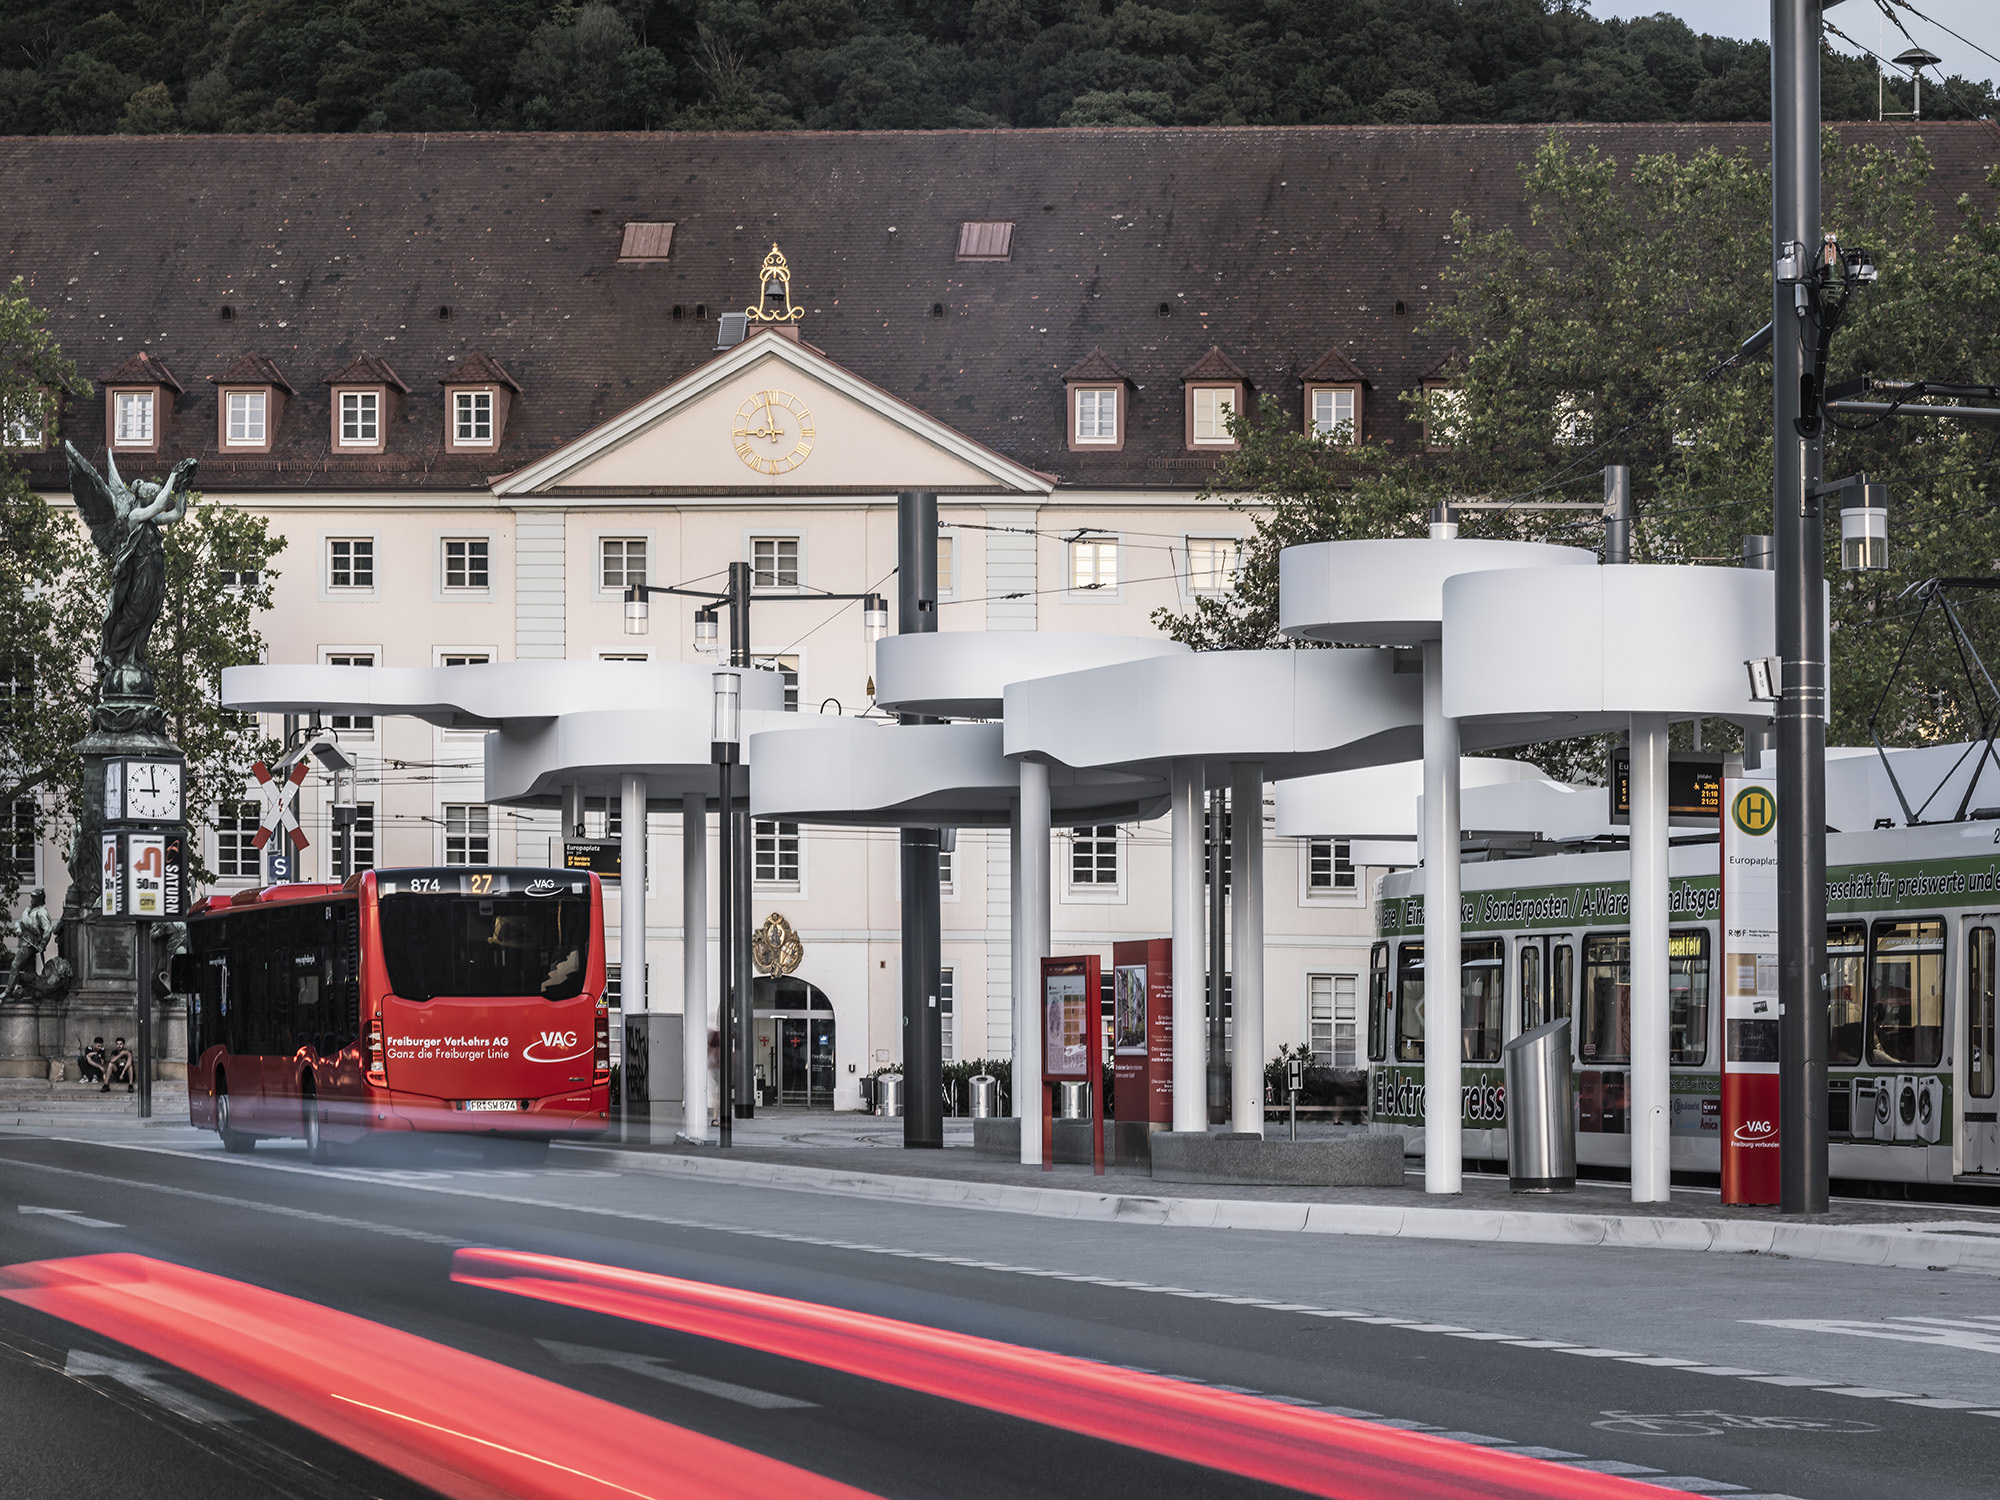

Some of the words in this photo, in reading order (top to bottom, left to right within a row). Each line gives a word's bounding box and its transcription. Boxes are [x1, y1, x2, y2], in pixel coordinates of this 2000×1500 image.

[1701, 790, 1719, 798] 21:18
[1746, 797, 1765, 825] H
[566, 844, 601, 853] Europaplatz
[274, 858, 287, 876] S
[165, 864, 179, 914] SATURN
[410, 878, 441, 893] 874
[471, 874, 493, 895] 27
[533, 879, 555, 889] VAG
[1484, 891, 1569, 928] Sonderposten
[1580, 887, 1630, 917] A-Ware
[1876, 871, 1895, 899] für
[1896, 870, 1966, 903] preiswerte
[1968, 864, 1995, 893] und
[1669, 936, 1701, 957] ieselfeld
[387, 1036, 441, 1049] Freiburger
[443, 1036, 490, 1047] Verkehrs
[492, 1036, 509, 1047] AG
[540, 1031, 577, 1047] VAG
[387, 1048, 415, 1059] Ganz
[417, 1047, 433, 1059] die
[435, 1047, 484, 1062] Freiburger
[487, 1048, 510, 1059] Linie
[1289, 1061, 1302, 1089] H
[471, 1101, 483, 1110] FR
[487, 1101, 499, 1110] SW
[500, 1101, 516, 1110] 874
[1461, 1073, 1507, 1122] reiss
[1700, 1117, 1718, 1130] Amica
[1746, 1120, 1772, 1133] VAG
[1730, 1140, 1754, 1150] Freiburg
[1754, 1141, 1780, 1149] verbunden
